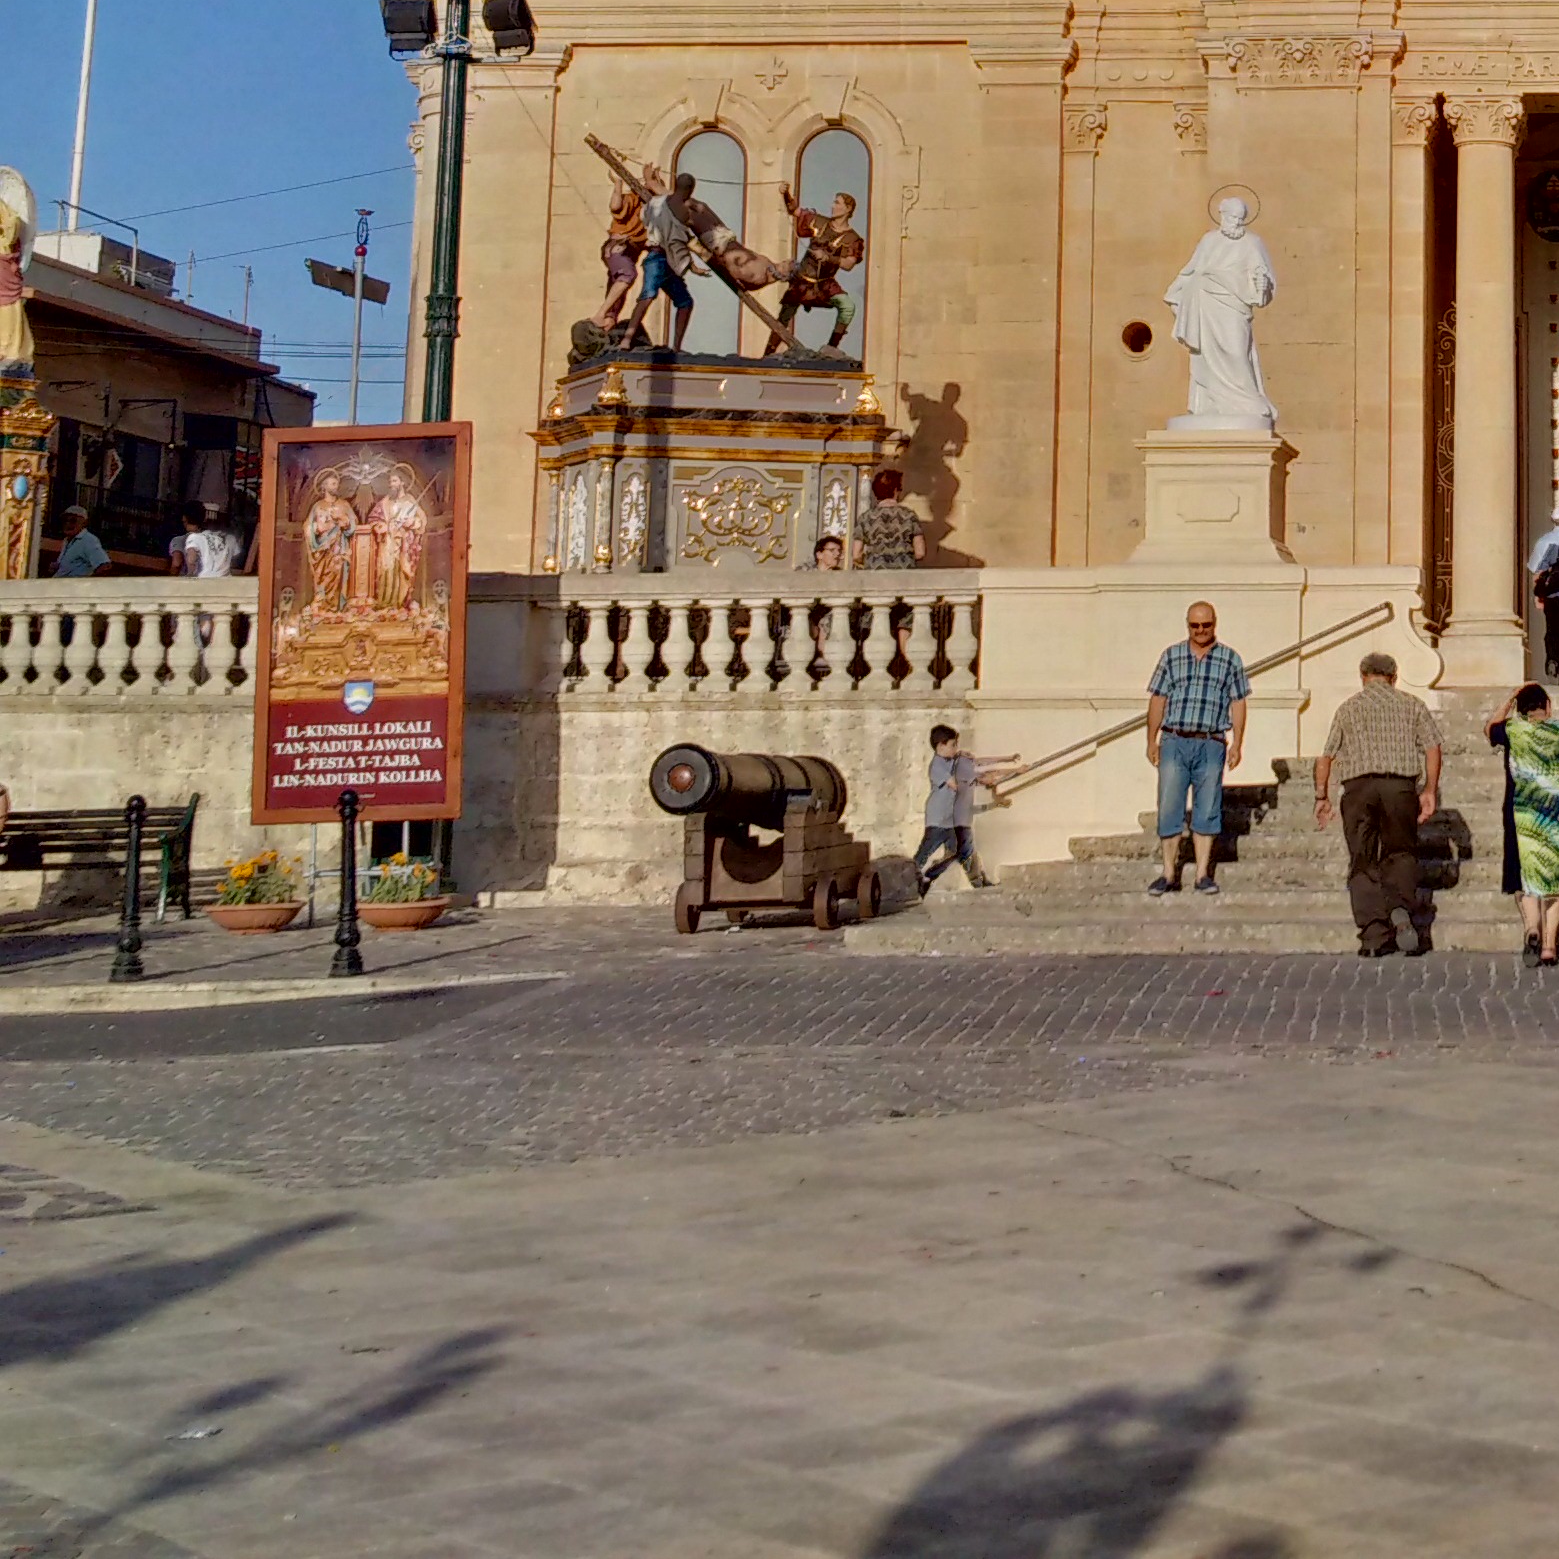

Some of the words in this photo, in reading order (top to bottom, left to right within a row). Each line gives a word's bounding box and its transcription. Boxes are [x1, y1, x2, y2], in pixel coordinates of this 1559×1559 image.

[285, 723, 372, 738] IL-KUNSILL
[375, 721, 431, 735] LOKALI
[272, 740, 363, 755] TAN-NADUR
[365, 737, 443, 751] JAWGURA
[294, 756, 356, 771] L-FESTA
[358, 754, 421, 768] T-TAJBA
[272, 771, 376, 788] LIN-NADURIN
[378, 769, 442, 785] KOLLHA
